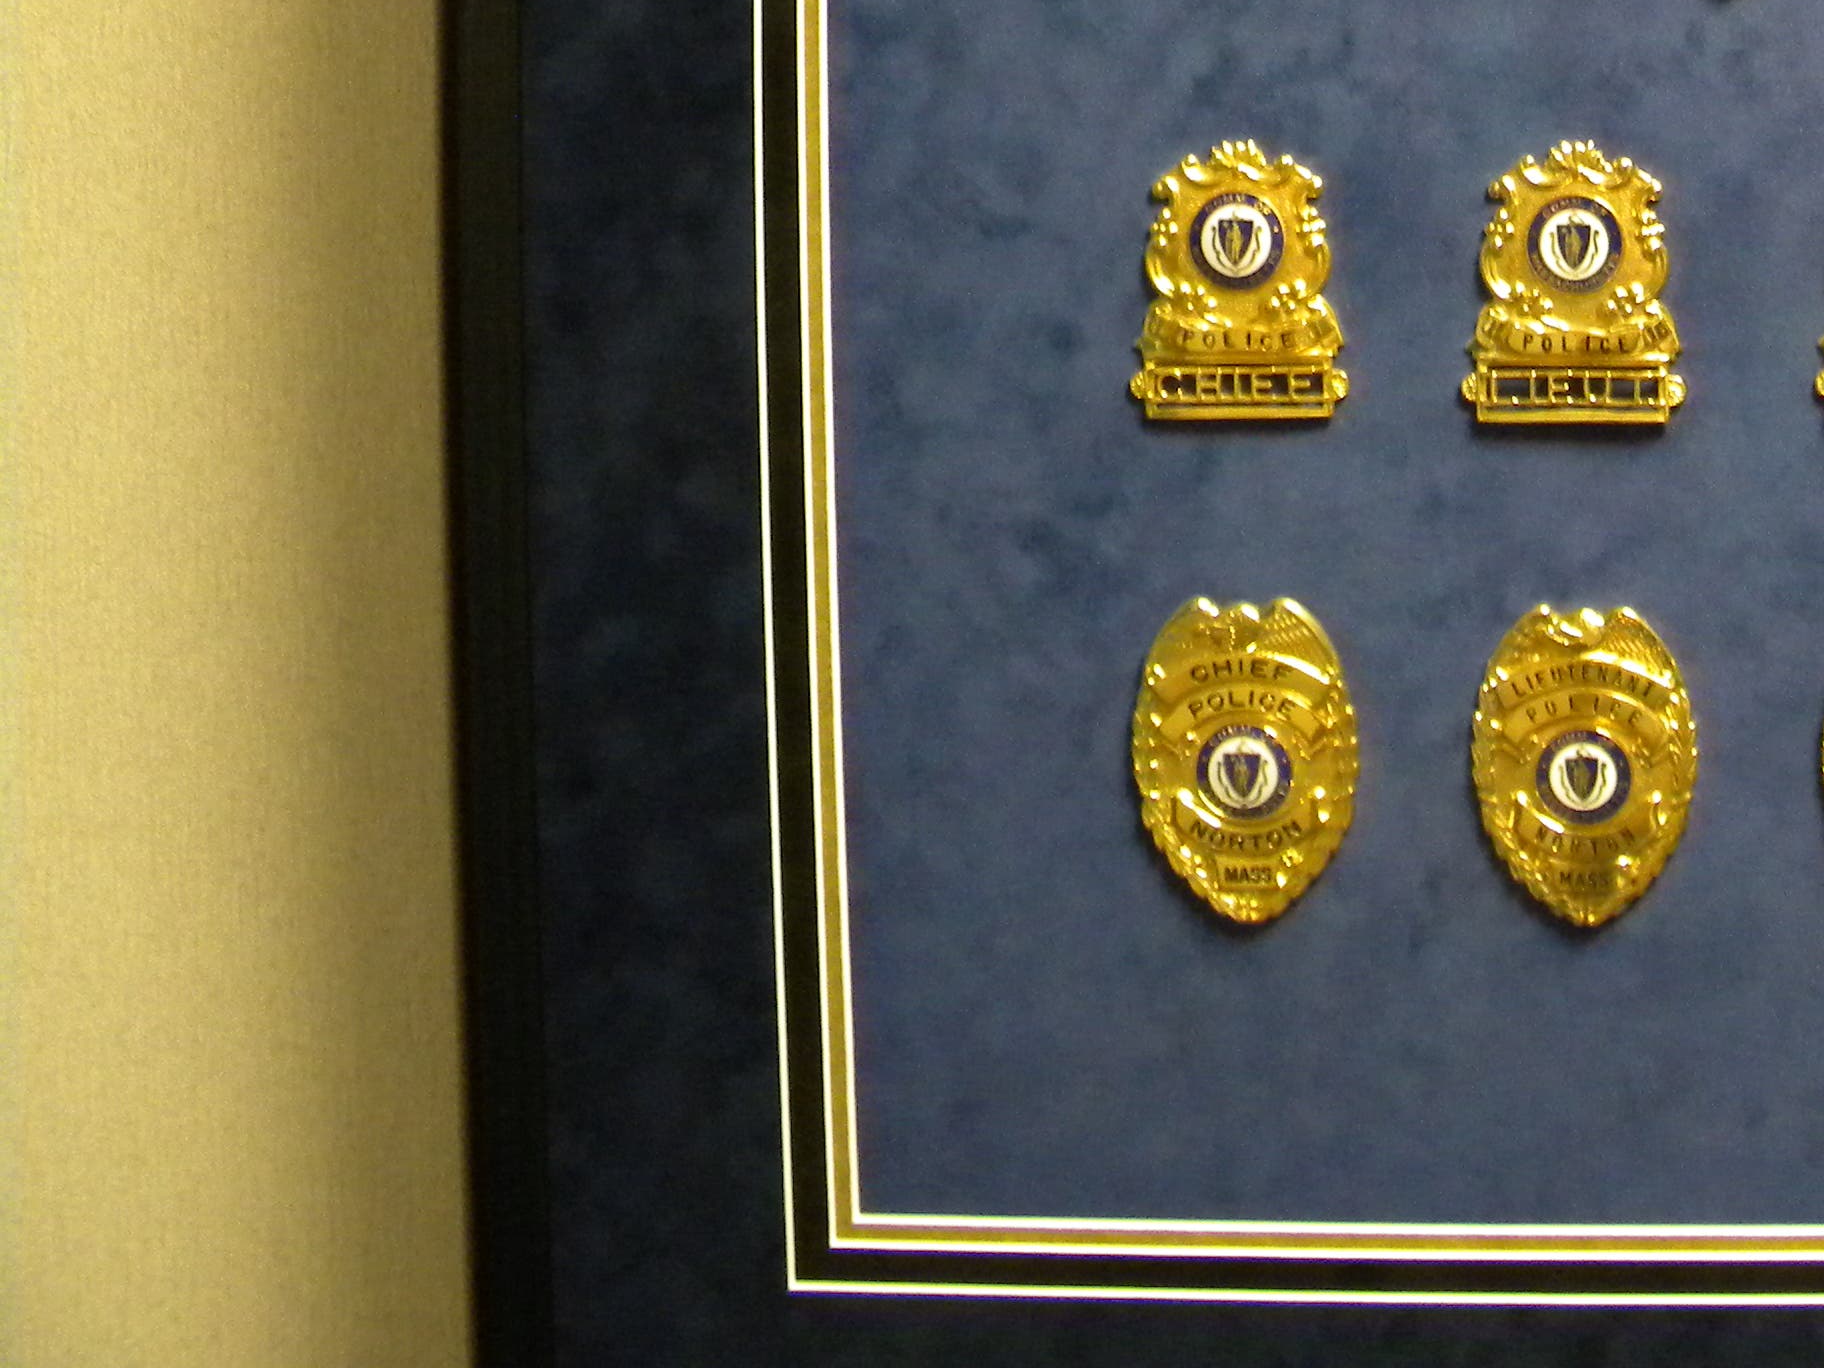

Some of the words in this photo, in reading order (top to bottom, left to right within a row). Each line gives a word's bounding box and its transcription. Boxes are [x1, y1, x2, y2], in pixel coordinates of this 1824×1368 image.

[1181, 331, 1297, 352] POLICE
[1522, 334, 1630, 354] POLICE
[1156, 366, 1317, 403] CHIEF
[1189, 658, 1295, 682] CHIEF
[1187, 690, 1297, 721] POLICE
[1525, 694, 1643, 728] POLICE
[1190, 820, 1303, 852] NORTON
